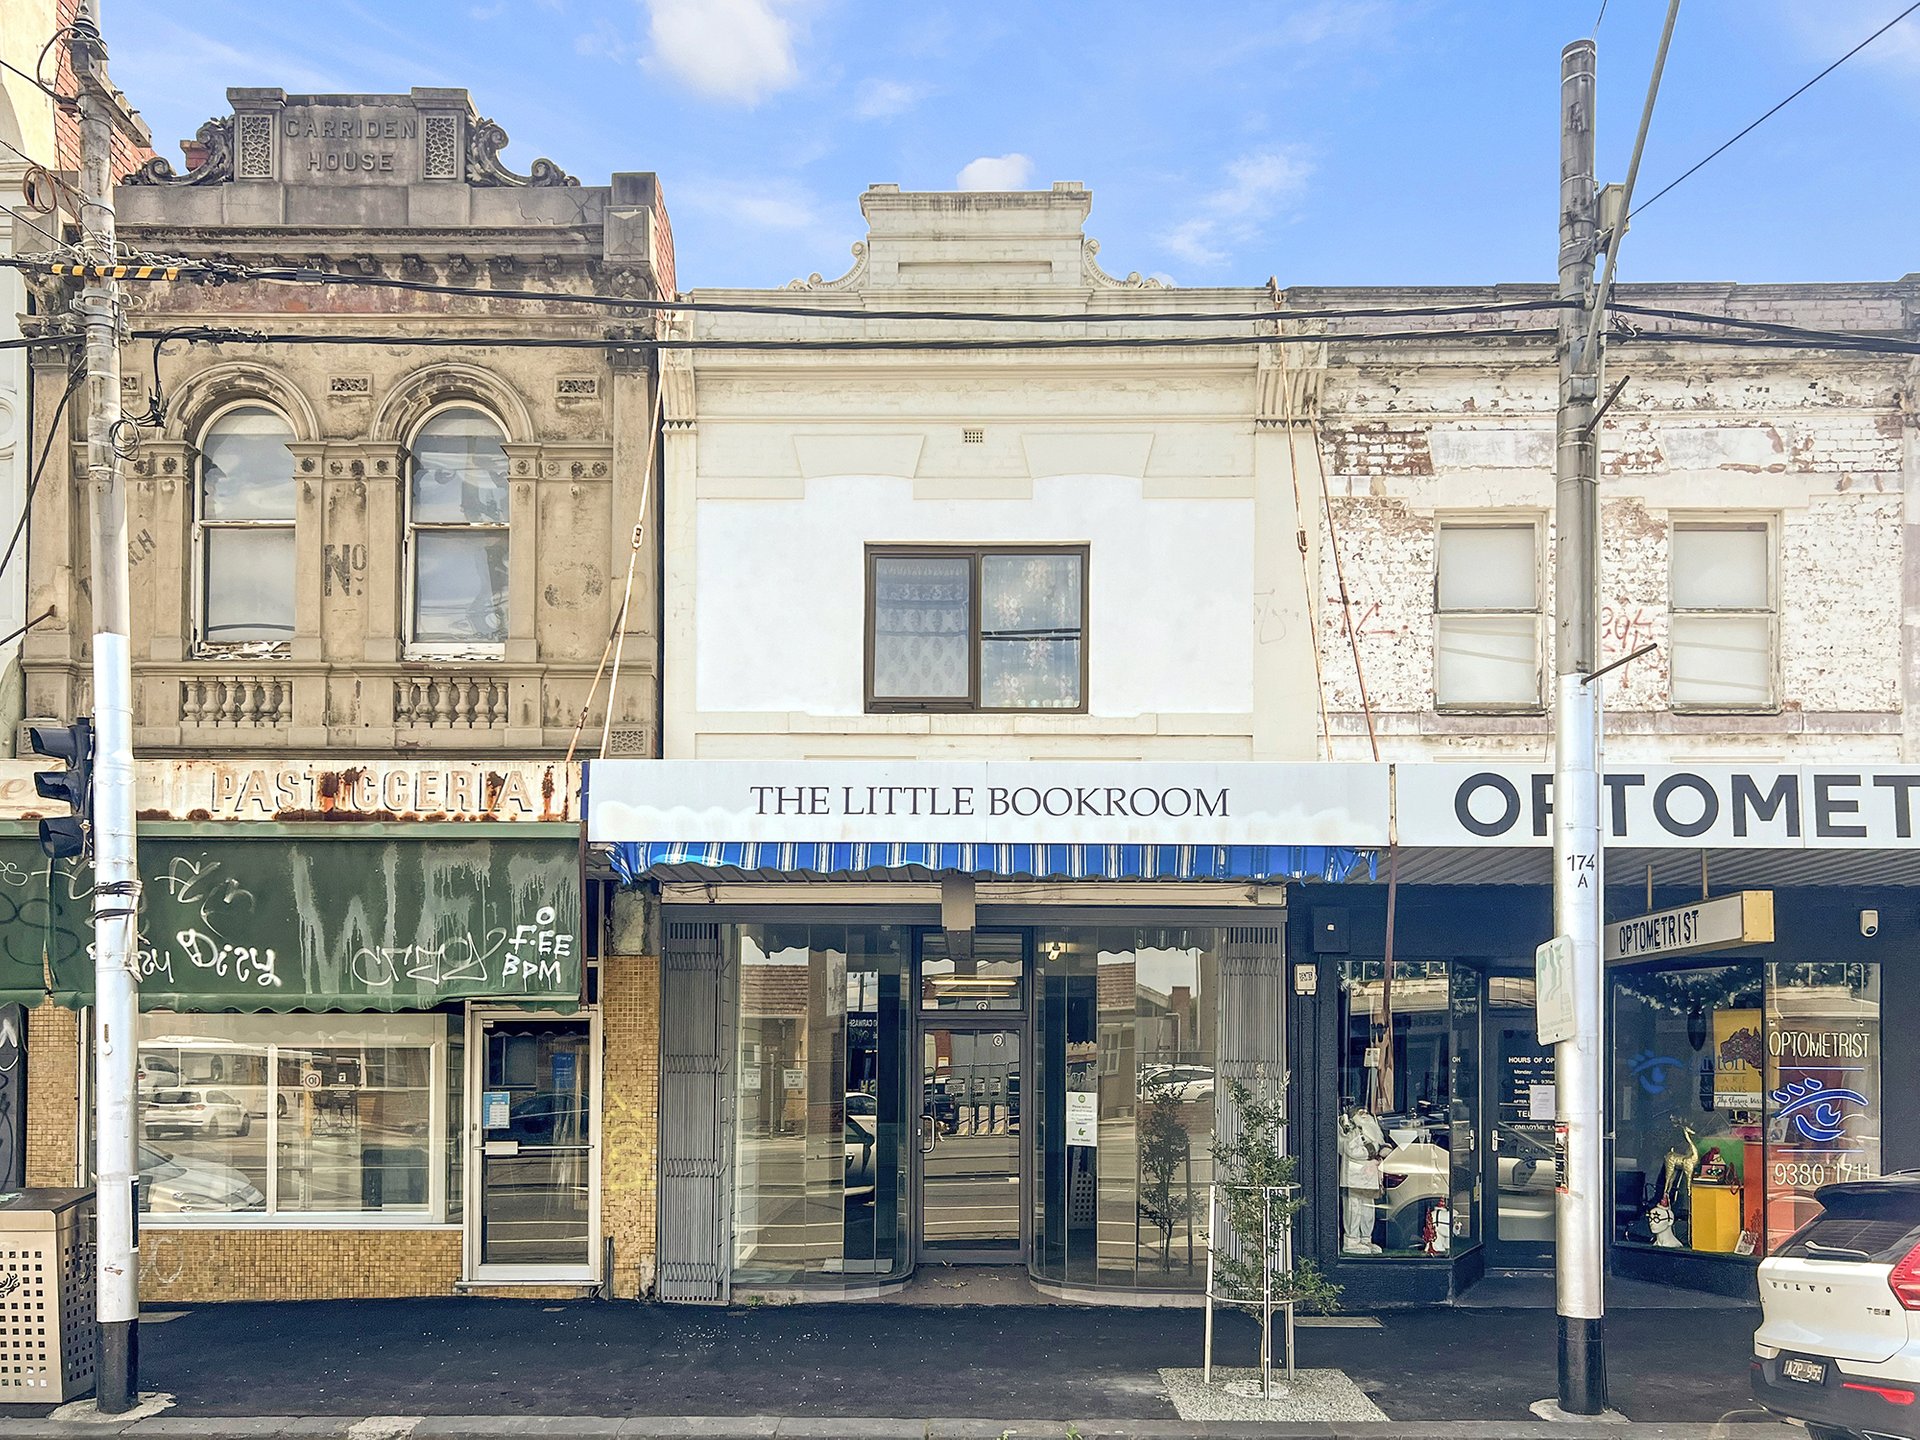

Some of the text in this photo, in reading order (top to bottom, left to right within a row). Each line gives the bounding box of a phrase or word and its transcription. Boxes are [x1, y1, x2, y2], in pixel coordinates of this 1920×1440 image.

[284, 119, 416, 139] CARRIDEN
[306, 152, 394, 172] HOUSE
[750, 786, 1230, 816] THE LITTLE BOOKROOM
[1567, 854, 1595, 871] 174
[1577, 873, 1588, 888] A
[1619, 909, 1699, 955] OPTOMETRIST
[1769, 1031, 1870, 1058] OPTOMETRIST
[1508, 1056, 1531, 1064] HOURS
[1774, 1163, 1825, 1186] 9380
[1772, 1281, 1832, 1293] VOLVO
